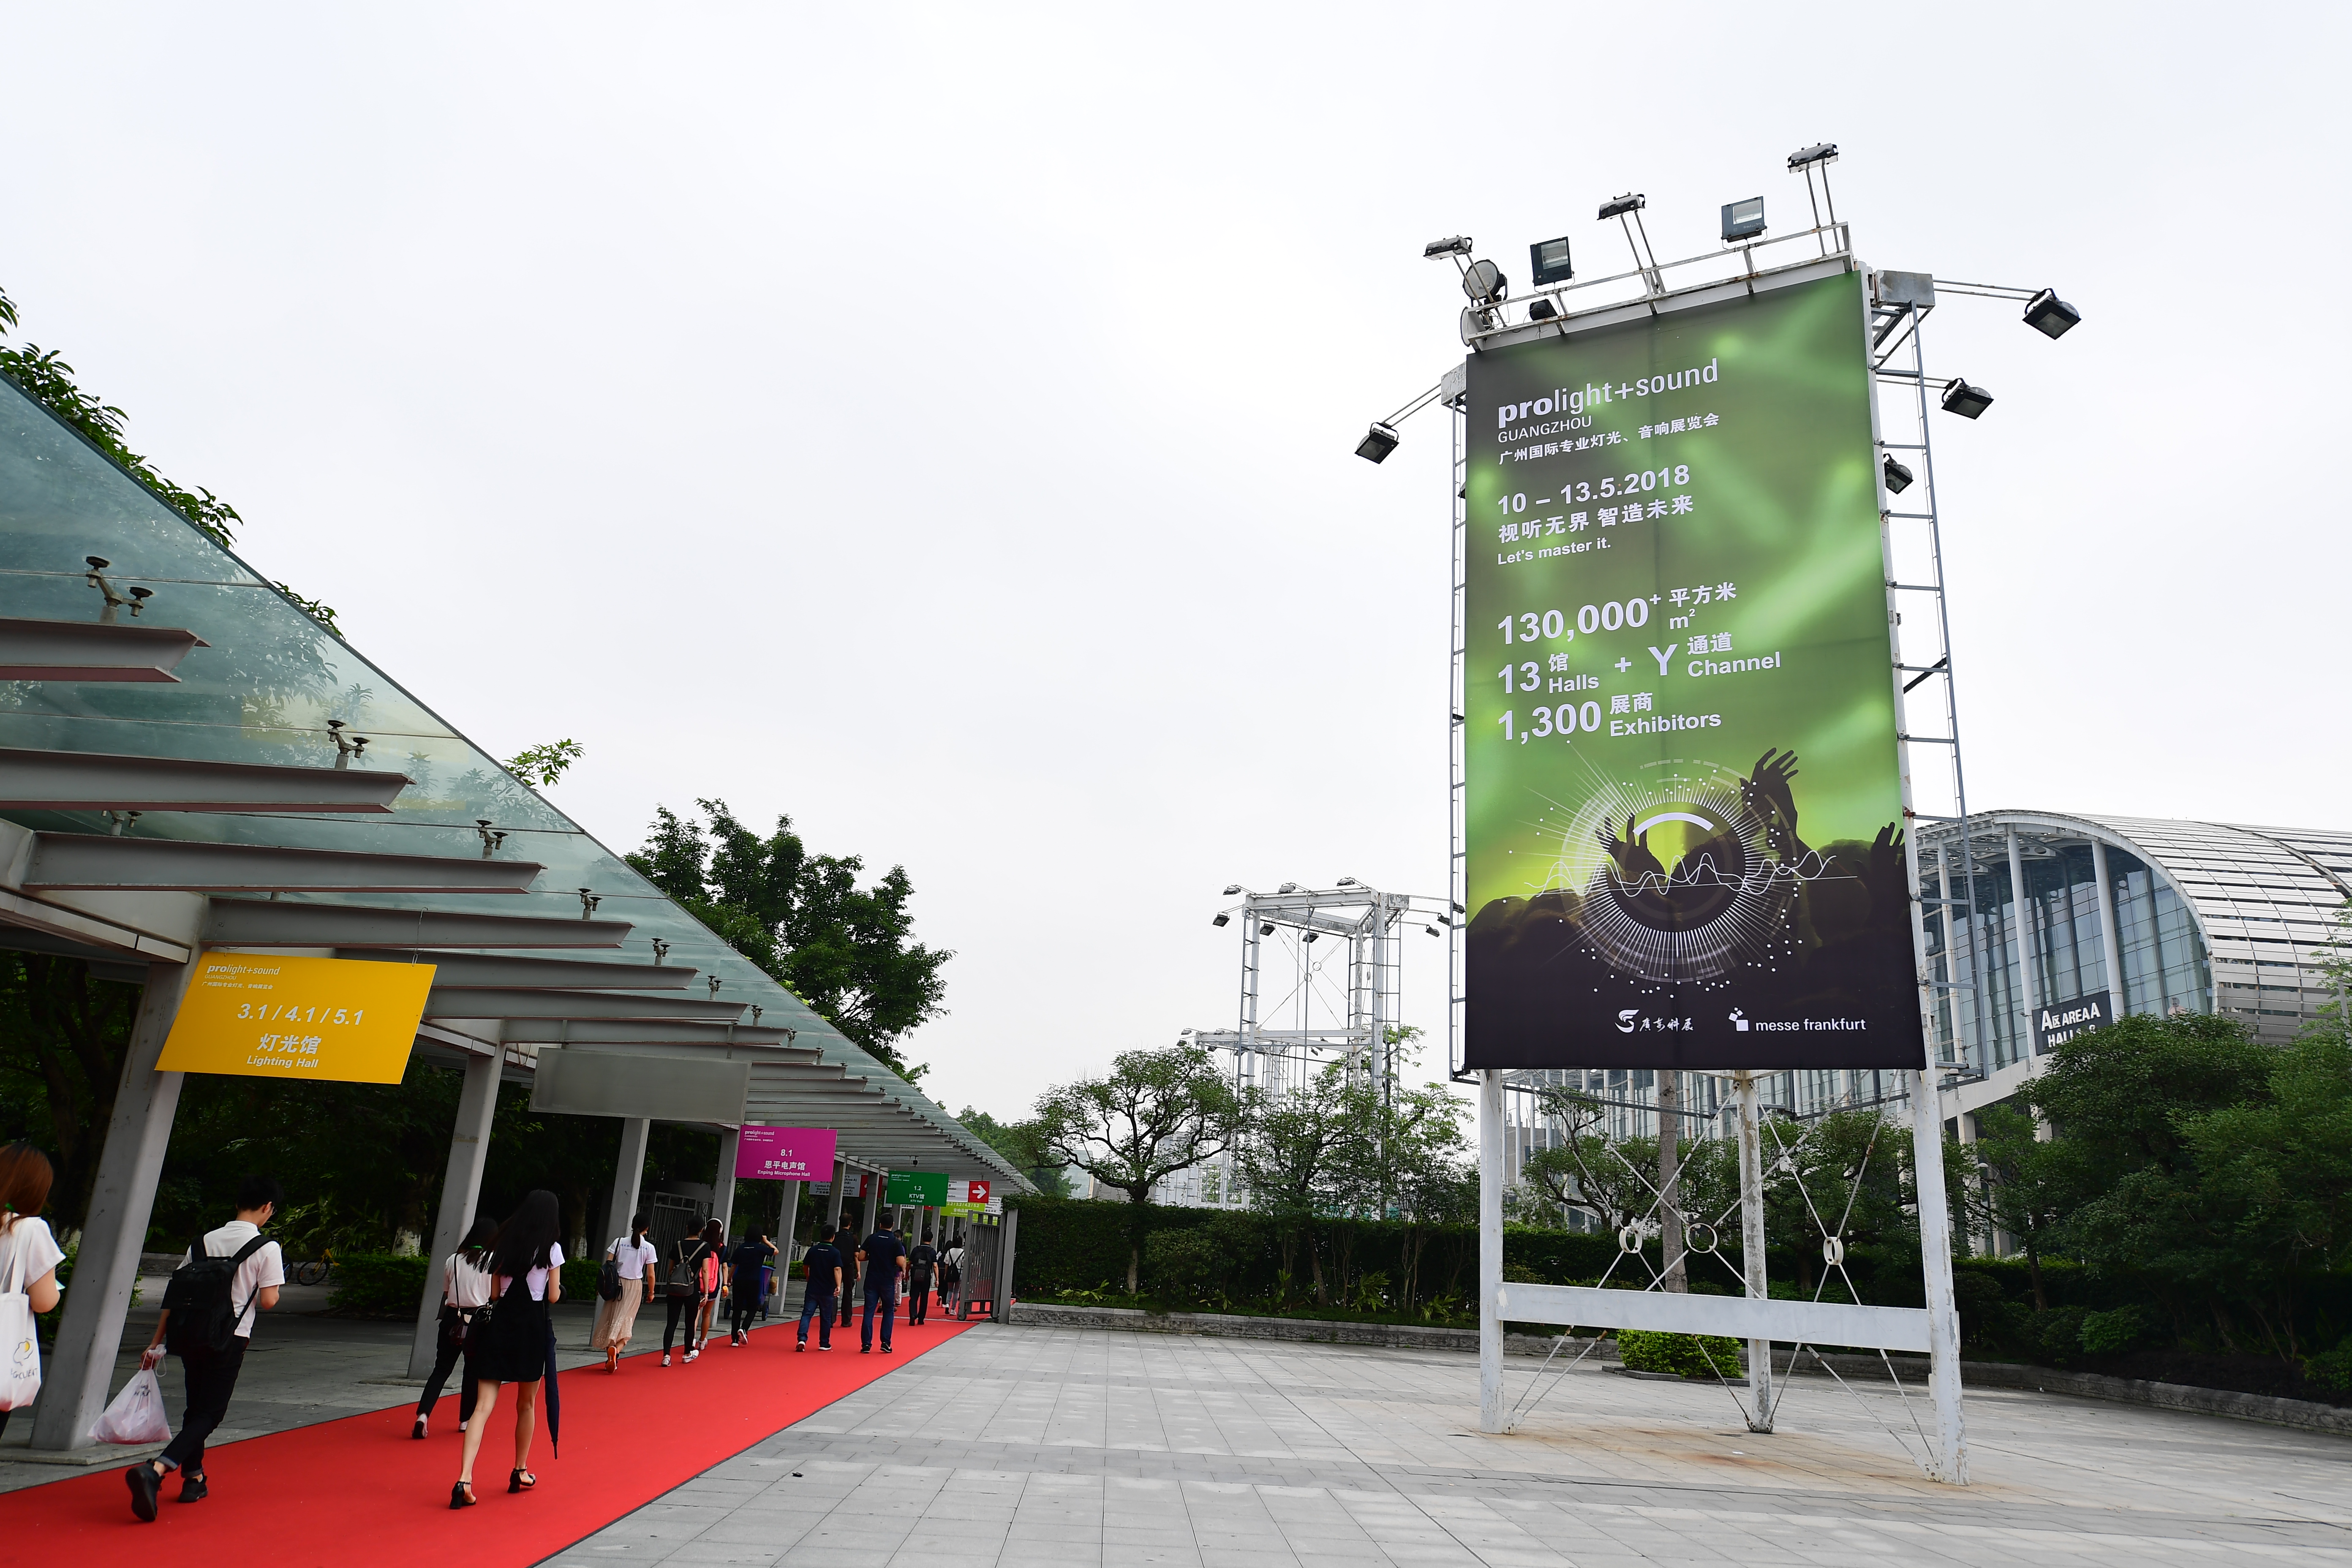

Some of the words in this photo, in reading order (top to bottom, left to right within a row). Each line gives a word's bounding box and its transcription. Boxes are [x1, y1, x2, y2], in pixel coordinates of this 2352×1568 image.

[1498, 357, 1718, 428] prolight+sound
[1498, 415, 1592, 443] GUANGZHOU
[1498, 493, 1527, 515] 10
[1560, 465, 1690, 504] 13.5.2018
[1498, 511, 1590, 544] 视听无界
[1597, 494, 1694, 527] 智造未来
[1498, 550, 1533, 565] Let's
[1538, 542, 1593, 558] master
[1597, 537, 1611, 550] it.
[1669, 582, 1737, 608] 平方米
[1498, 662, 1541, 694] 13
[1548, 652, 1569, 673] 馆
[1647, 644, 1679, 676] Y
[1687, 632, 1733, 656] 通道
[1549, 674, 1600, 694] Halls
[1688, 651, 1781, 678] Channel
[1498, 701, 1601, 745] 1,300
[1609, 692, 1653, 715] 展商
[1610, 714, 1722, 737] Exhibitors
[207, 964, 281, 975] prolight+sound
[237, 1003, 268, 1020] 3.1
[285, 1006, 316, 1023] 4.1
[333, 1009, 364, 1026] 5.1
[1756, 1021, 1800, 1032] messe
[1803, 1018, 1867, 1031] frankfurt
[2062, 1007, 2091, 1026] AREA
[257, 1033, 322, 1055] 灯光馆
[247, 1055, 293, 1068] Lighting
[296, 1058, 319, 1068] Hall
[764, 1160, 806, 1171] 恩平电声馆
